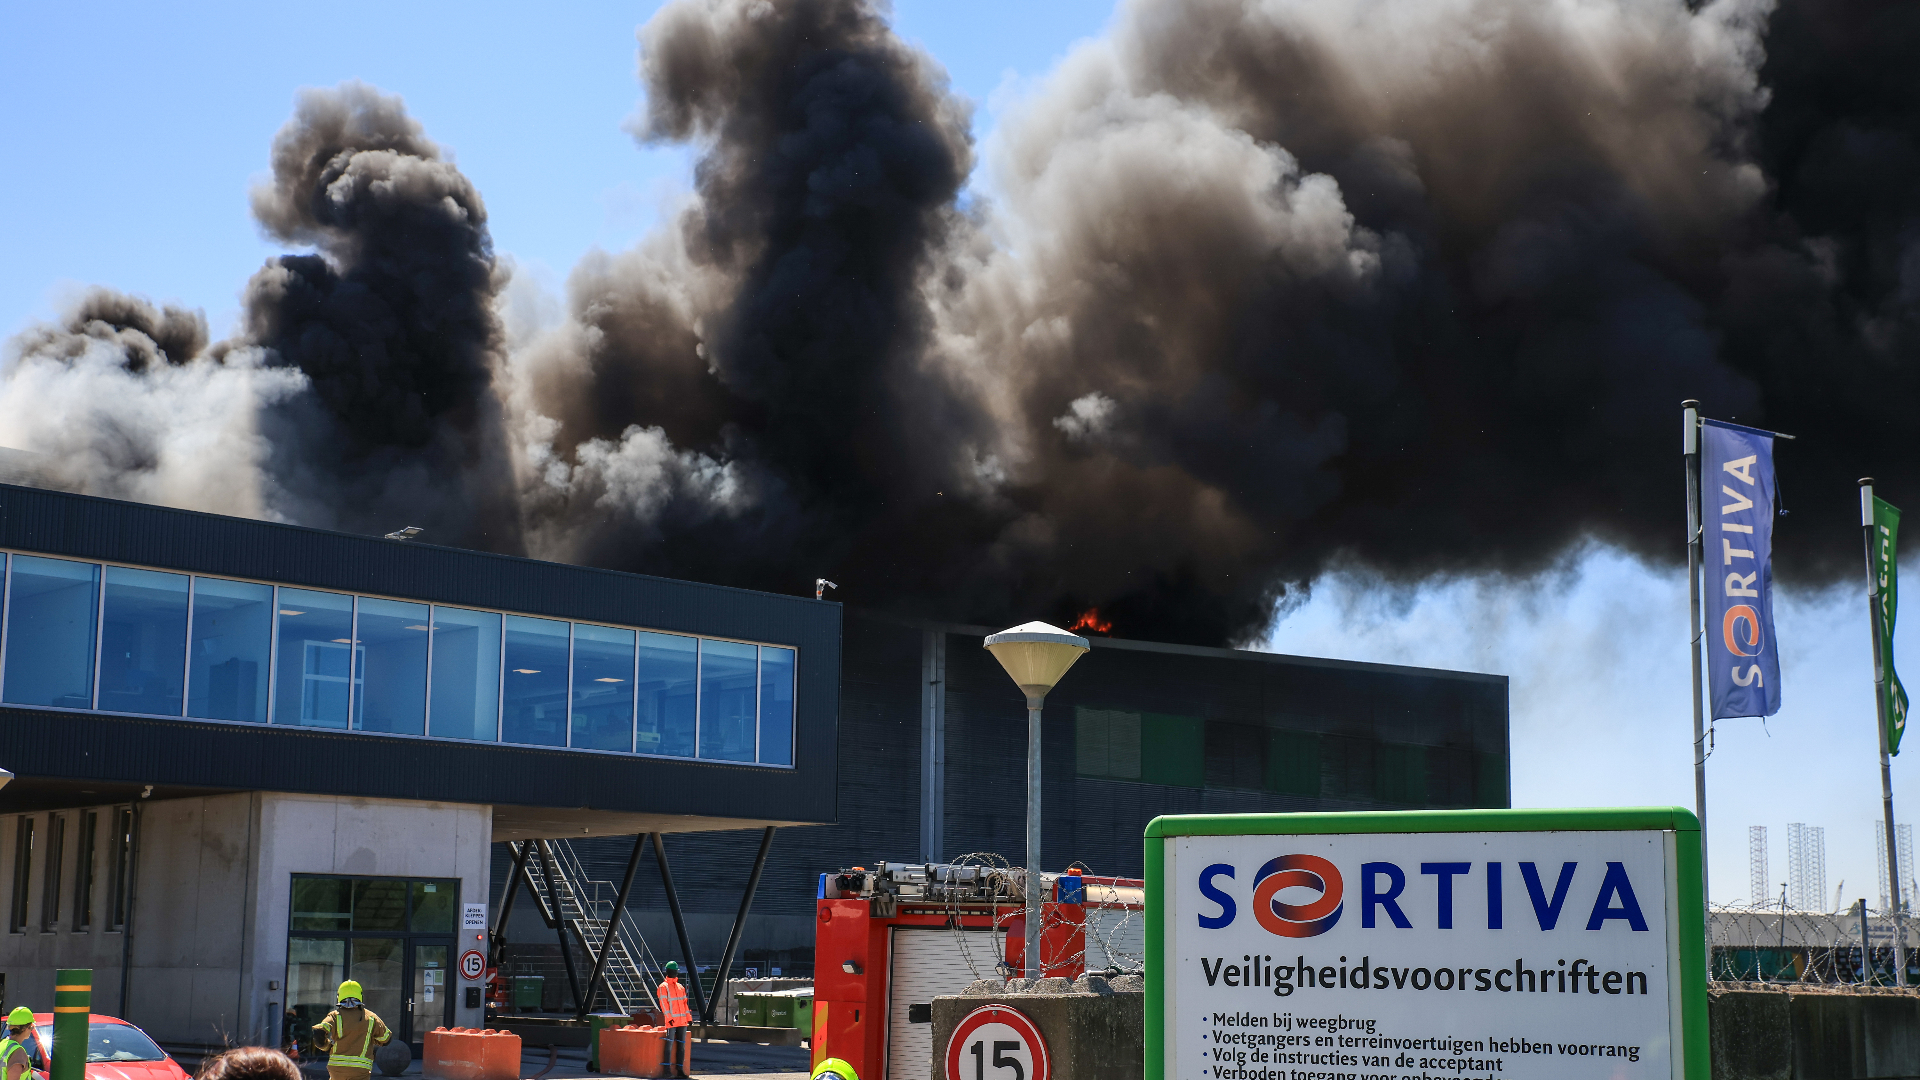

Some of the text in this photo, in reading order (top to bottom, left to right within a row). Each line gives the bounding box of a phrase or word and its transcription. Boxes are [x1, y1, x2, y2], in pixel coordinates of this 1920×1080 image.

[1722, 454, 1765, 689] SORTIVA
[1197, 852, 1650, 939] SORTIVA
[466, 957, 481, 972] 15
[1200, 954, 1649, 997] Veiligheidsvoorschriften
[1212, 1011, 1377, 1035] Melden bij weegbrug
[970, 1040, 1025, 1080] 15
[1211, 1029, 1641, 1063] Voetgangers en terreinvoertuigen hebben voorrang
[1212, 1046, 1504, 1075] Volg de instructies van de acceptant
[1212, 1064, 1286, 1080] Verboden
